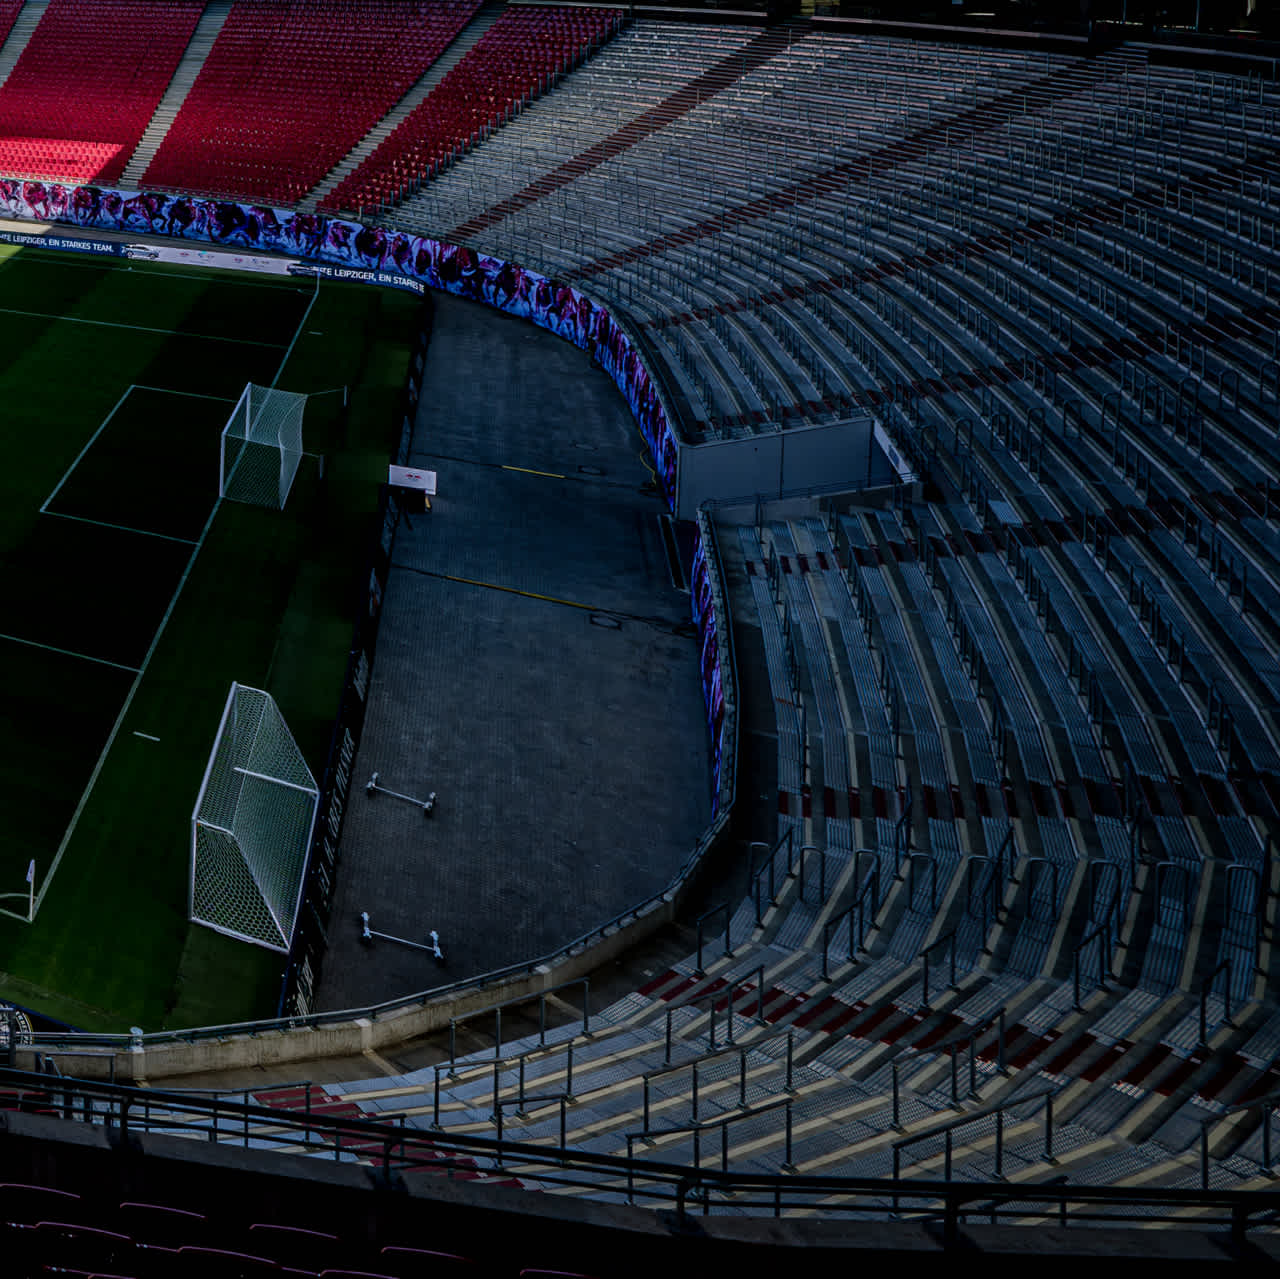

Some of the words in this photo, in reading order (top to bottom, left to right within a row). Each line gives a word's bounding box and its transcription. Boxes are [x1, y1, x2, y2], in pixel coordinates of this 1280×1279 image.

[12, 234, 47, 246] LEIPZIGER,
[48, 238, 60, 247] EIN
[61, 240, 91, 250] STARKES
[93, 243, 115, 253] TEAM.
[334, 269, 377, 282] LEIPZIGER,
[378, 273, 391, 283] EIN
